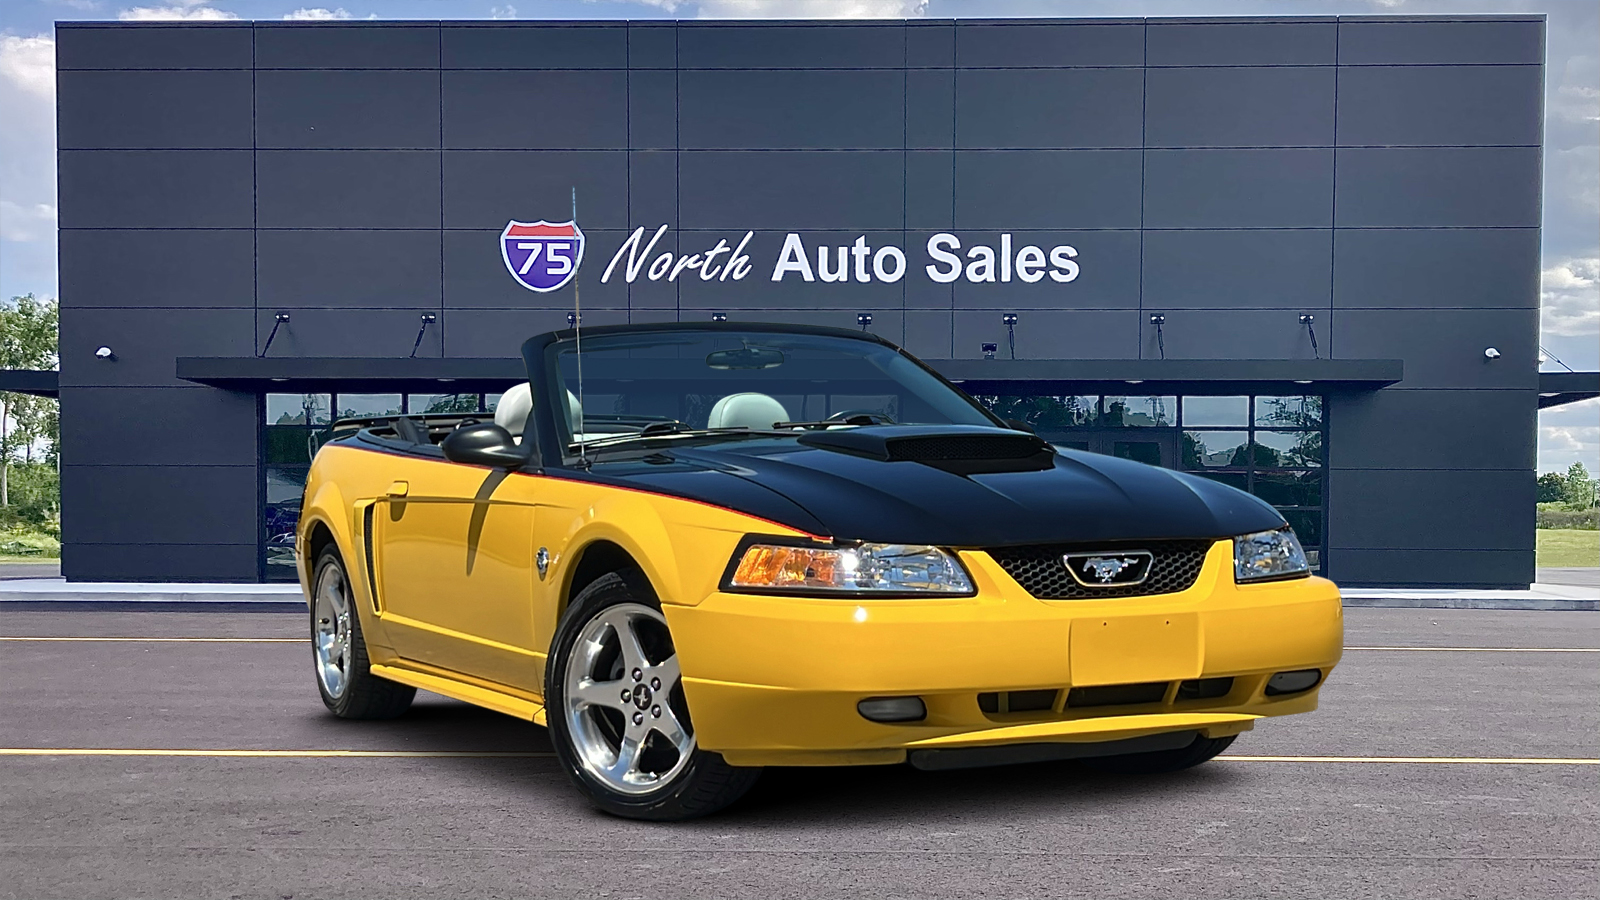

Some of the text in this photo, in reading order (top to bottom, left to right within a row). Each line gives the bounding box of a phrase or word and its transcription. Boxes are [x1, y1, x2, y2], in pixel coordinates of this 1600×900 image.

[517, 224, 1080, 284] 75 North Auto Sales
